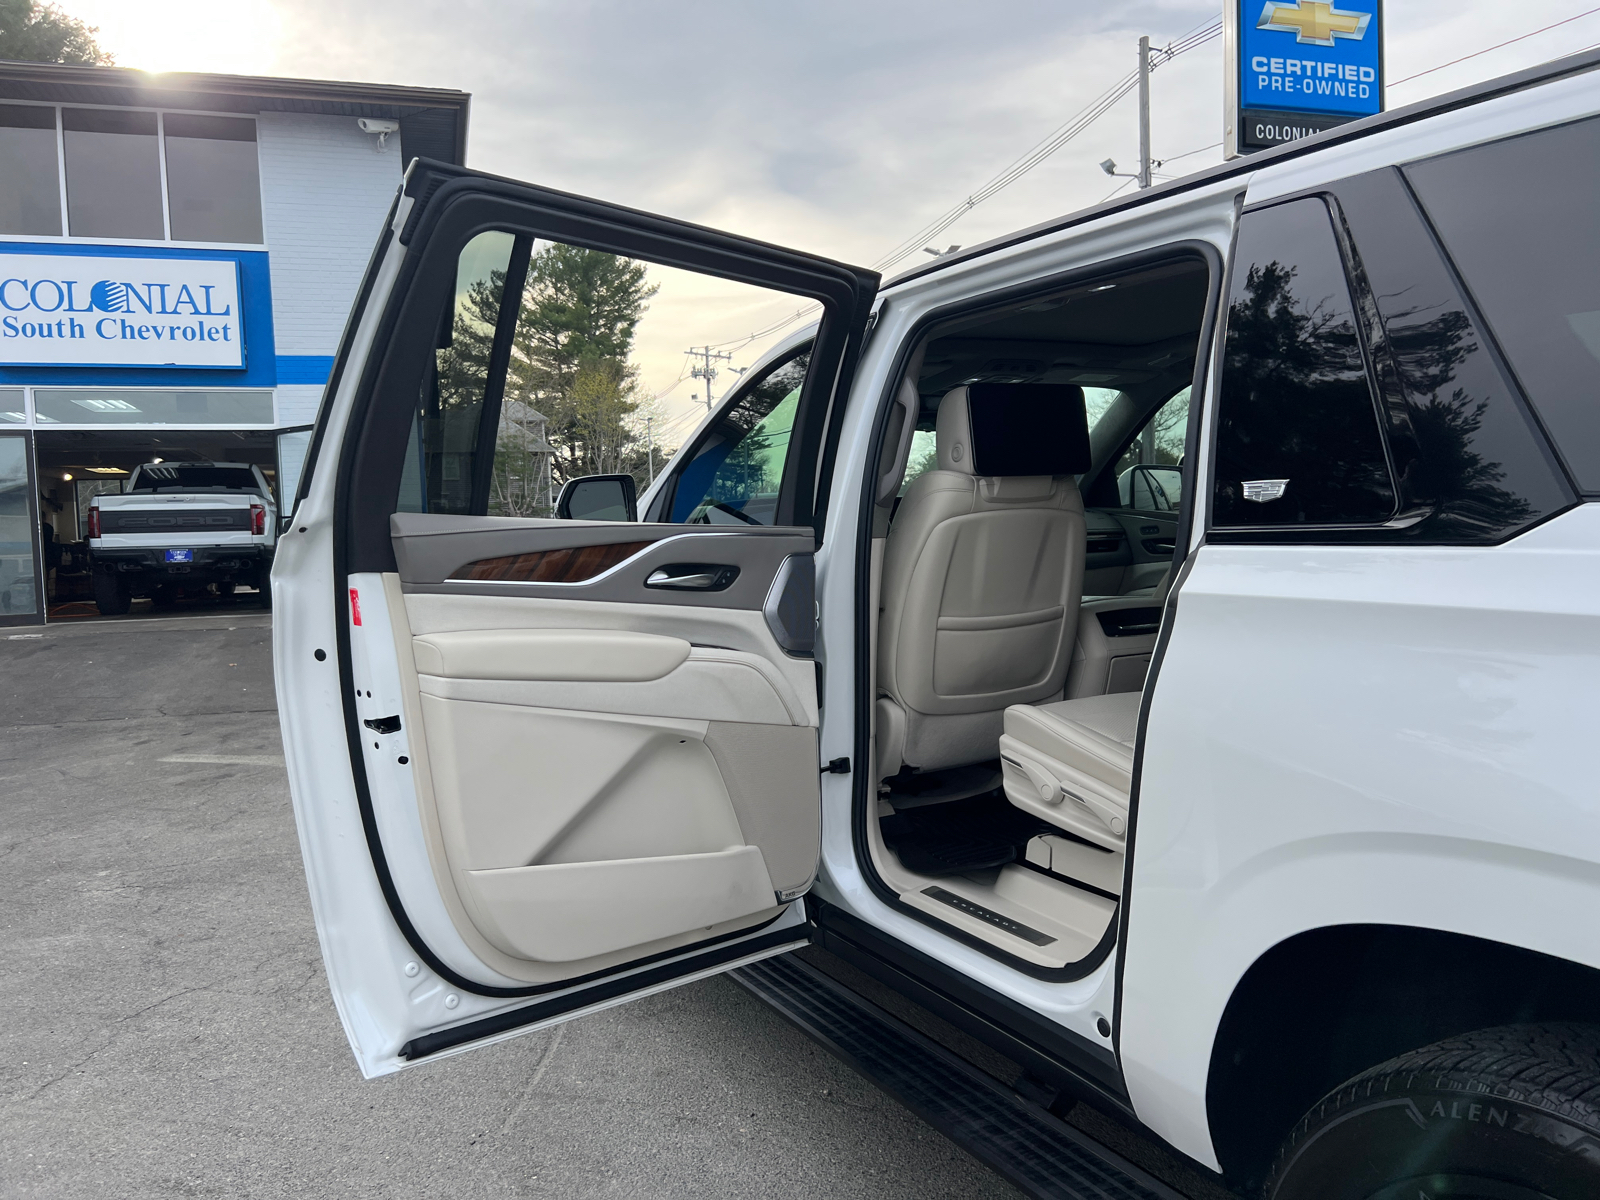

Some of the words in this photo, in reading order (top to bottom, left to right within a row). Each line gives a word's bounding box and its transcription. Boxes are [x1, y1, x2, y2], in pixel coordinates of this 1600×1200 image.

[1252, 56, 1375, 82] CERTIFIED
[1258, 75, 1370, 98] PRE-OWNED
[0, 278, 230, 316] COLONIAL
[2, 316, 85, 339] South
[95, 317, 232, 341] Chevrolet
[118, 516, 234, 527] FORD
